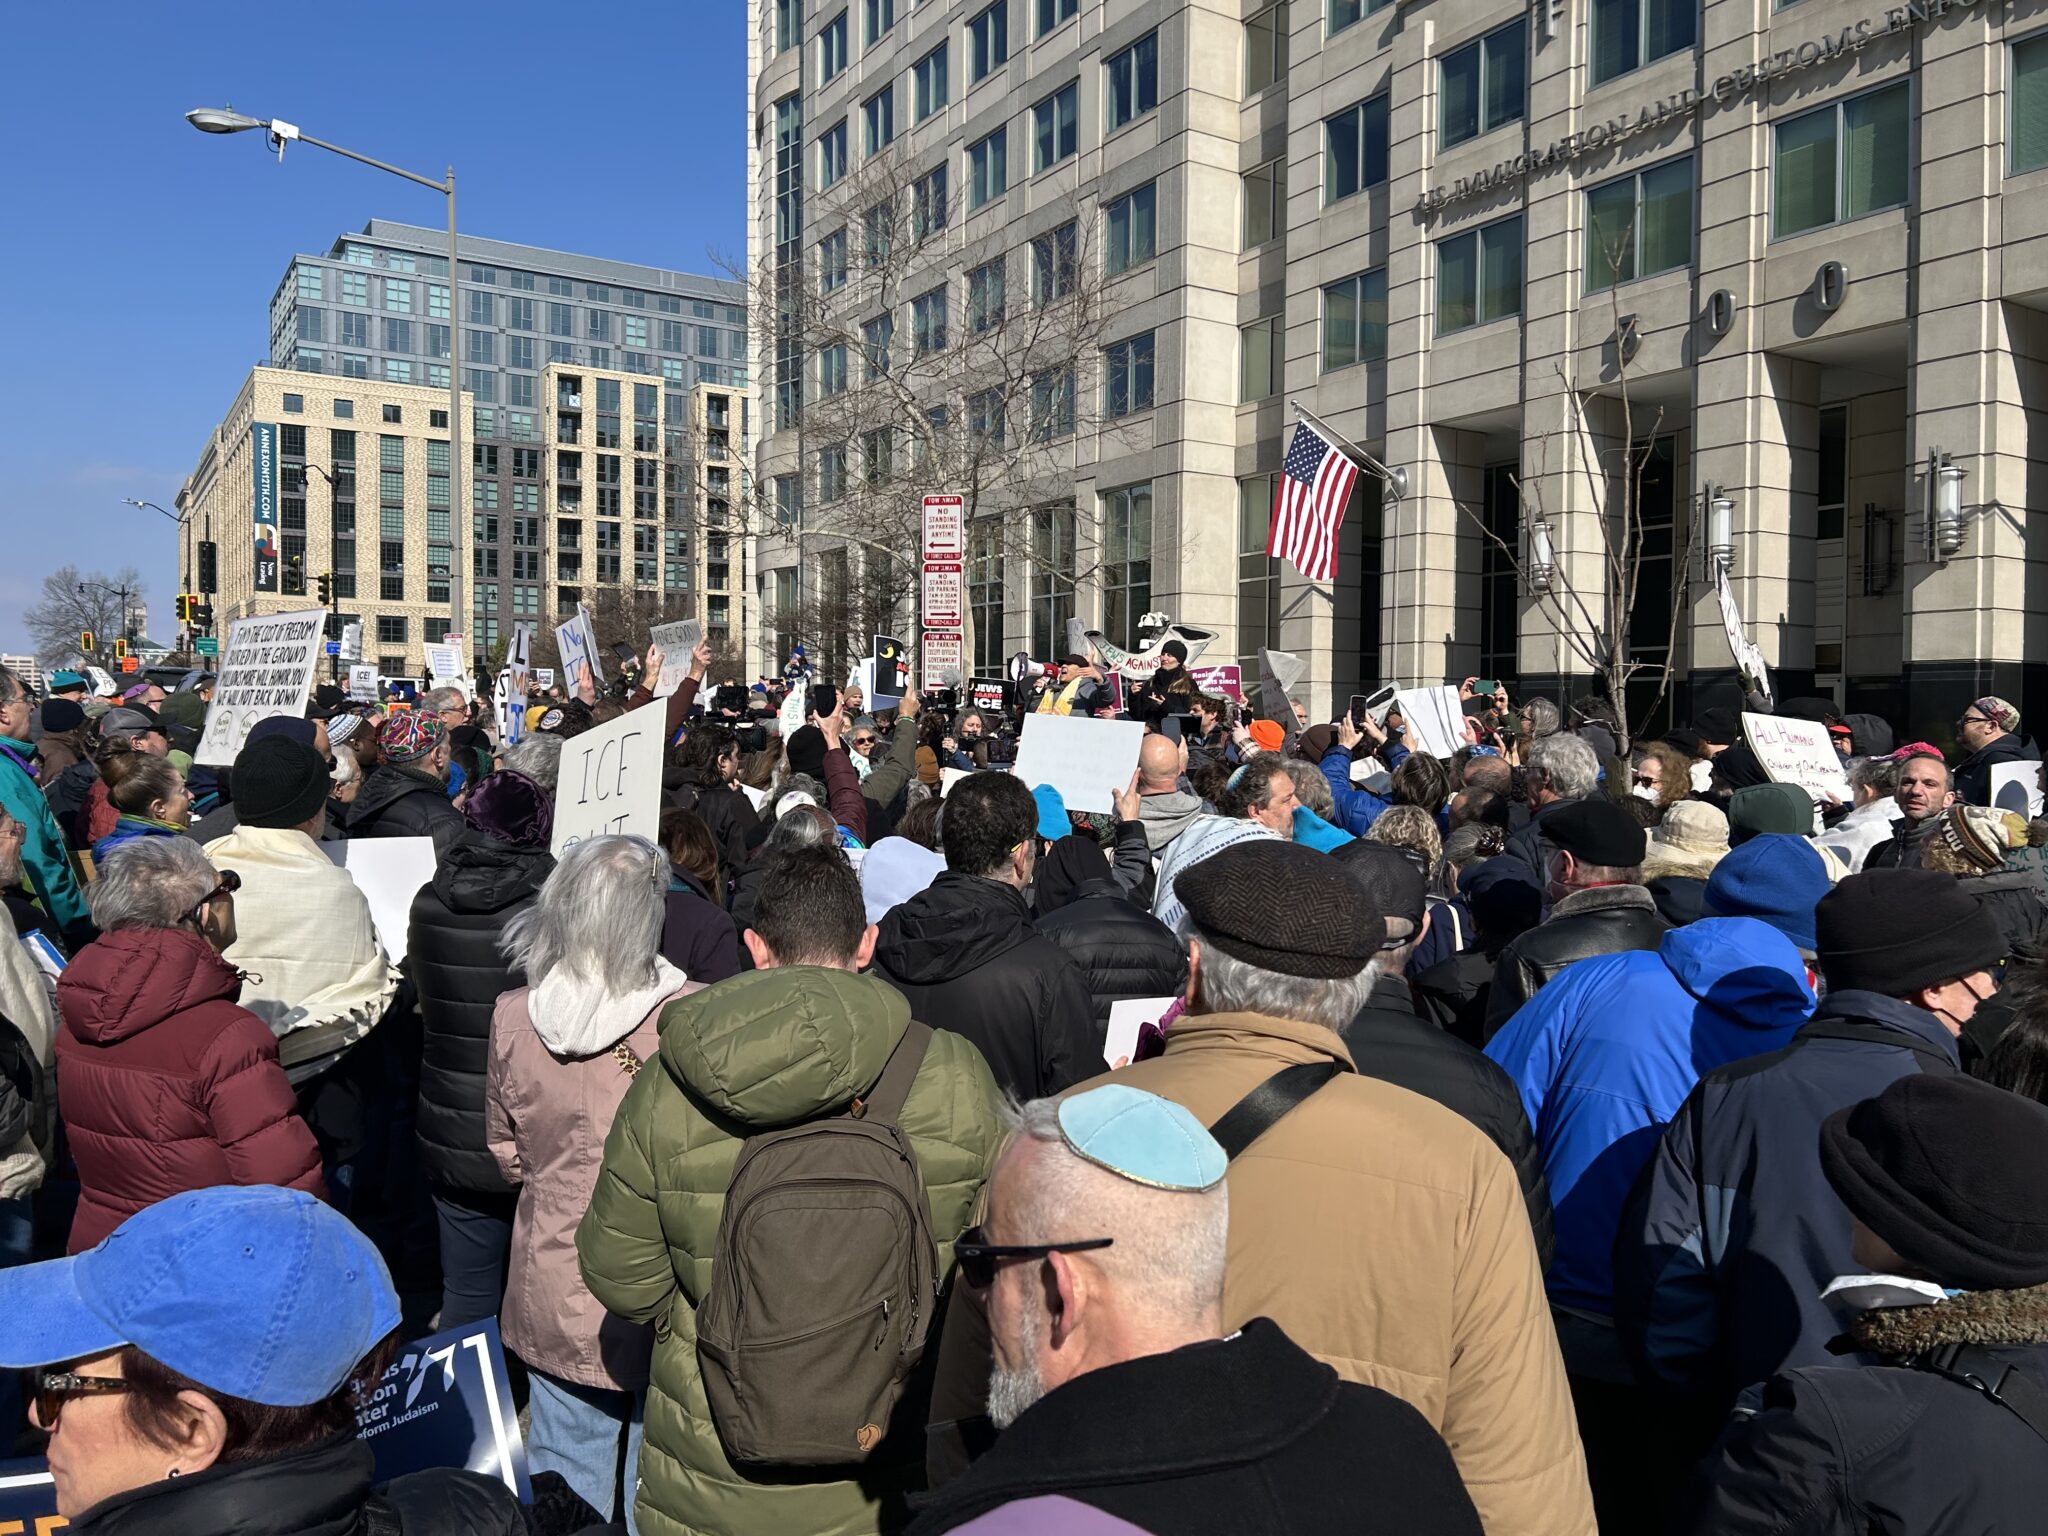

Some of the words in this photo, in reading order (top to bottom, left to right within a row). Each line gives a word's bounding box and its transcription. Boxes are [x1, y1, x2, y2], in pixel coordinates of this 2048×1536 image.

[1454, 113, 1628, 199] IMMIGRATION
[1637, 88, 1700, 130] AND
[1712, 18, 1873, 102] CUSTOMS
[1884, 0, 1977, 33] ENF
[261, 427, 271, 519] ANNEXON12TH.COM
[250, 624, 264, 643] THE
[260, 623, 279, 643] COST
[283, 619, 317, 642] FREEDOM
[227, 648, 251, 666] BURIED
[249, 647, 261, 665] IN
[259, 646, 273, 664] THE
[271, 645, 307, 664] GROUND
[1100, 641, 1125, 664] JEWS
[1125, 655, 1161, 671] AGAINS
[255, 668, 270, 686] WILL
[267, 668, 292, 686] HONOR
[289, 667, 307, 686] YOU
[216, 689, 229, 706] WE
[226, 688, 241, 706] WILL
[237, 688, 256, 706] NOT
[253, 688, 274, 706] BACK
[272, 688, 302, 706] DOWN
[974, 691, 1003, 699] AGAINST
[975, 683, 1003, 694] JEWS
[787, 696, 801, 720] THIS
[973, 697, 1003, 710] ICE
[577, 732, 642, 805] ICE
[1942, 820, 1965, 852] YOU
[356, 1421, 391, 1439] eform
[391, 1401, 439, 1428] Judaism
